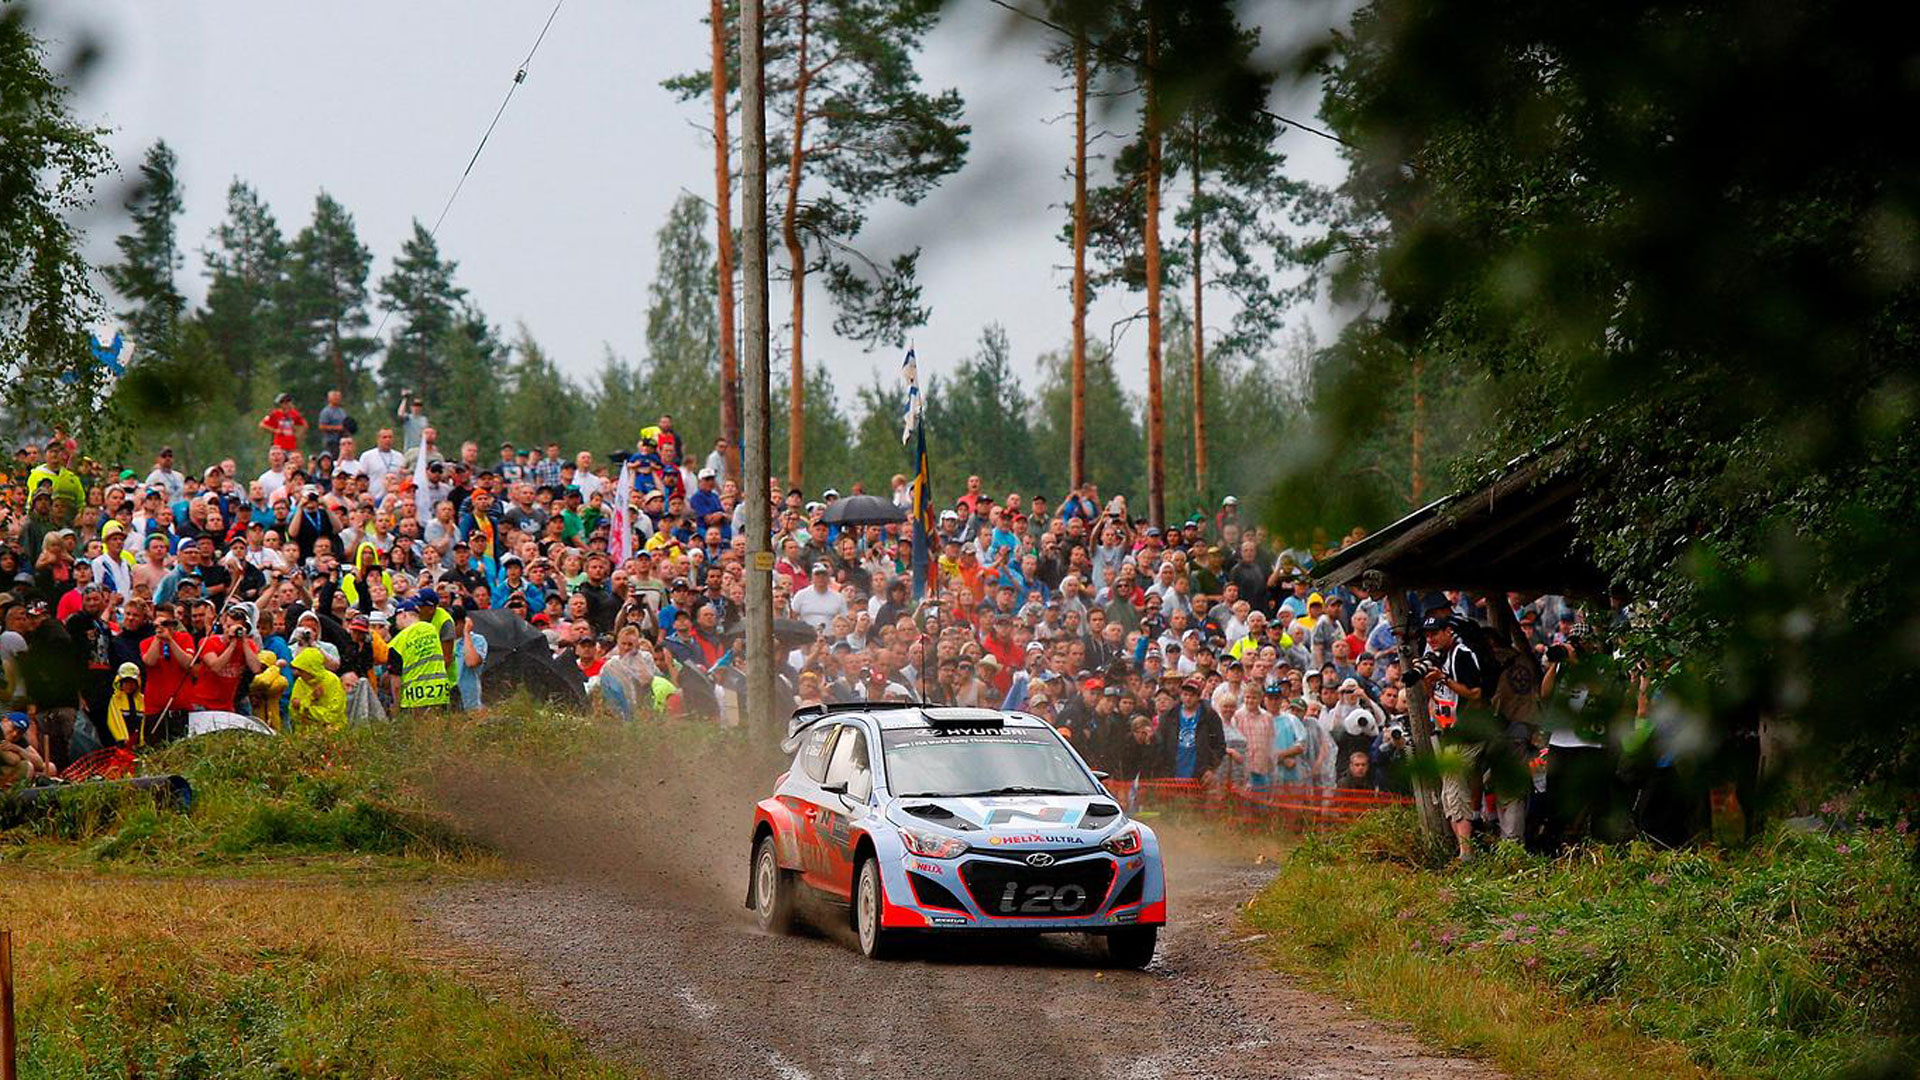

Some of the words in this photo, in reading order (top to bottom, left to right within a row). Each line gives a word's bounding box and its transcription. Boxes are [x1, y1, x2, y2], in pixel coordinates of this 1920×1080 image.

[946, 728, 1028, 736] HYUNDAI
[1002, 834, 1042, 844] HELIX
[1045, 835, 1085, 846] ULTRA
